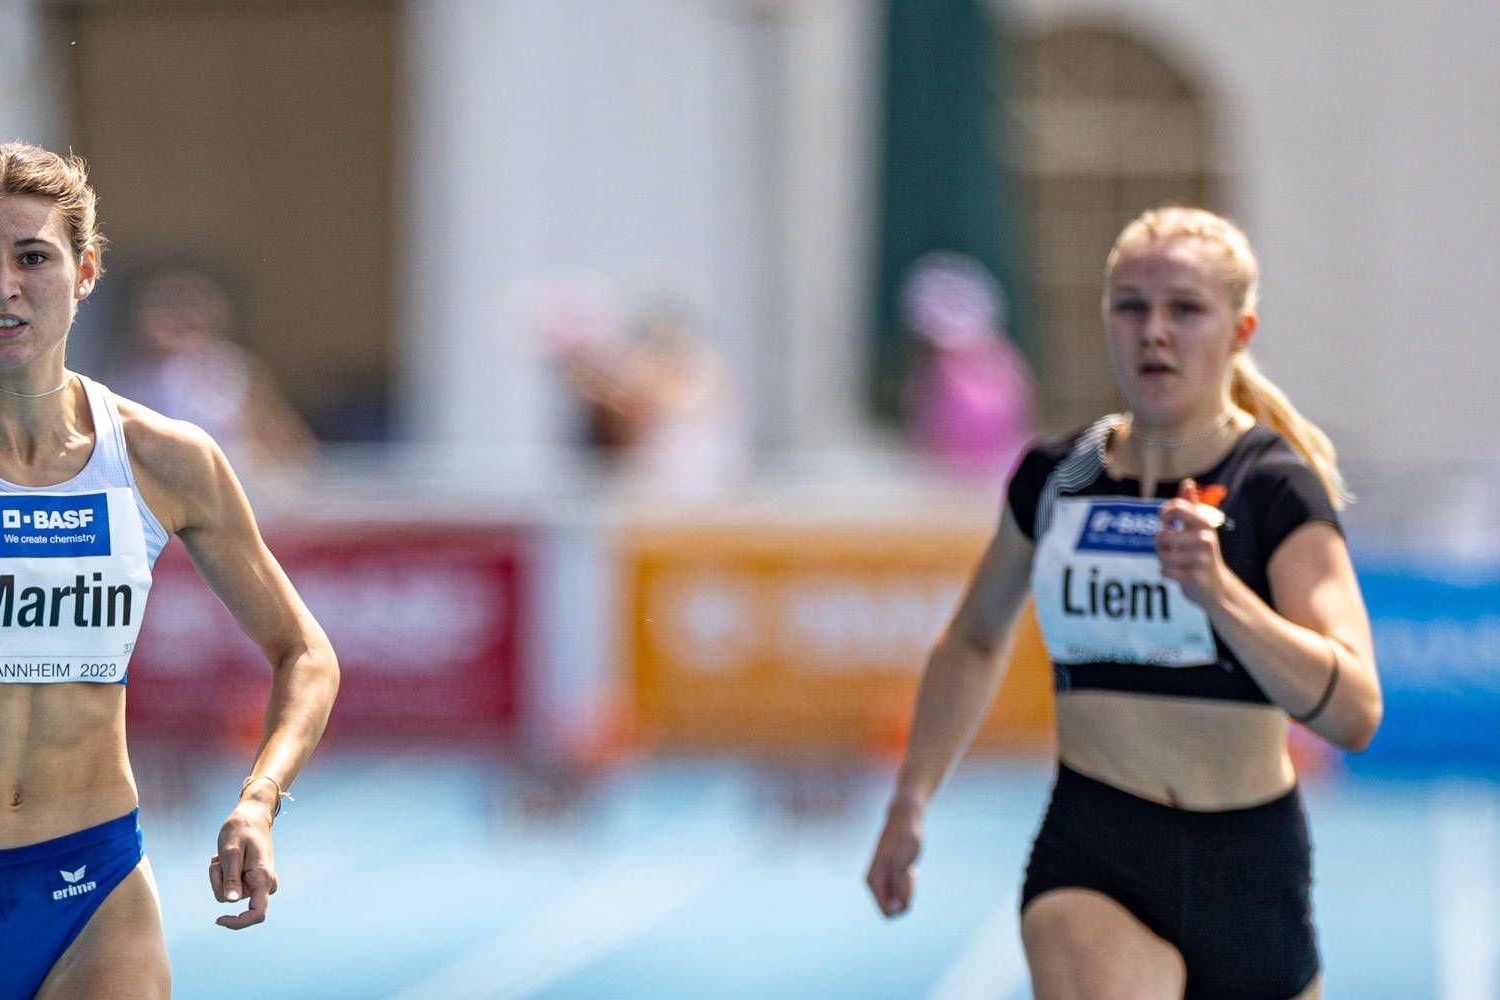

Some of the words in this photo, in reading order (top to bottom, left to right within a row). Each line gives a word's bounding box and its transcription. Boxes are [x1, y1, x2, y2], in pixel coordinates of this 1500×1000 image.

[33, 508, 94, 530] BASF
[1117, 511, 1161, 536] BAS
[4, 533, 20, 544] We
[20, 534, 48, 544] create
[49, 533, 96, 545] chemistry
[1063, 565, 1170, 620] Liem
[80, 663, 117, 678] 2023
[53, 881, 97, 901] erima
